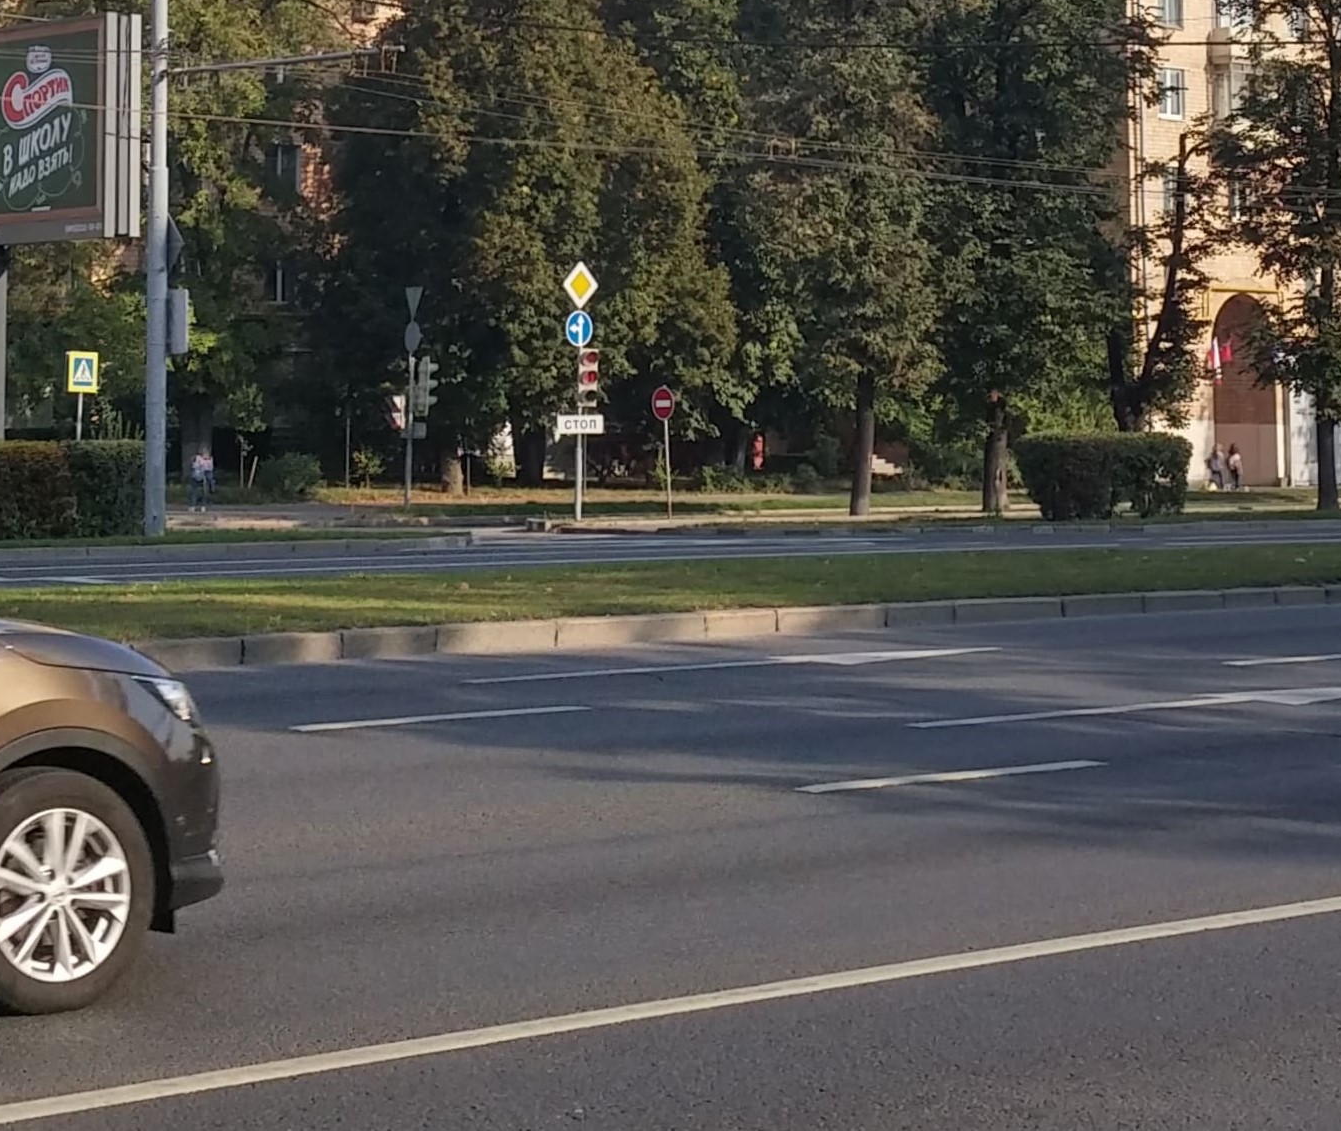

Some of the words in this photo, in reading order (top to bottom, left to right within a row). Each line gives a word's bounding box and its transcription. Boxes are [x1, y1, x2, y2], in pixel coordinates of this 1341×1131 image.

[3, 143, 14, 177] В
[18, 112, 72, 167] ШКОЛУ
[8, 164, 37, 199] НАДО
[37, 143, 74, 181] ВЗЯТЬ!
[564, 419, 597, 430] СТОП
